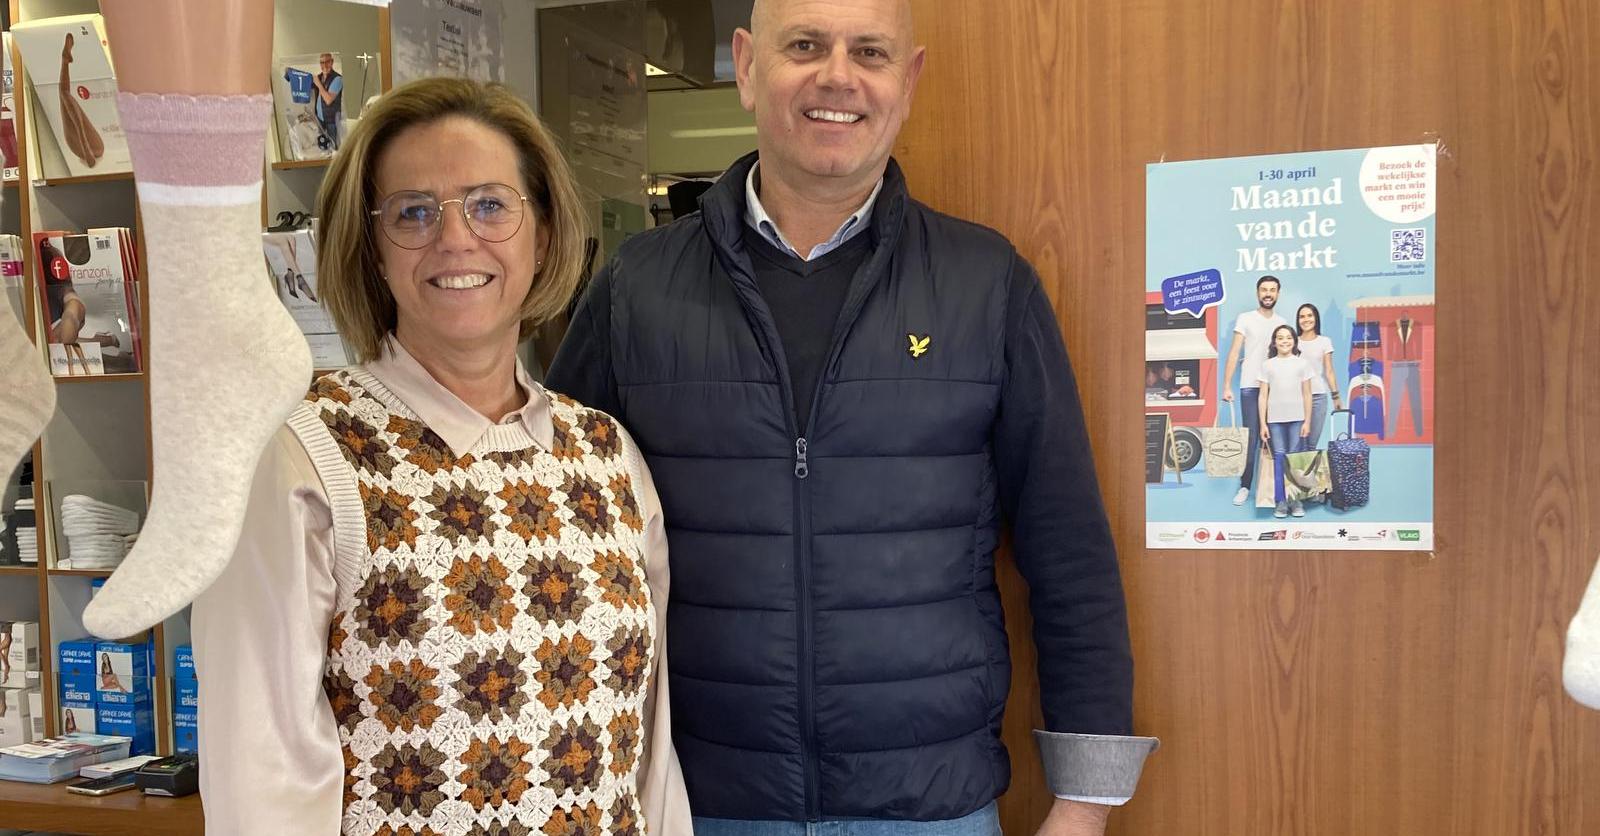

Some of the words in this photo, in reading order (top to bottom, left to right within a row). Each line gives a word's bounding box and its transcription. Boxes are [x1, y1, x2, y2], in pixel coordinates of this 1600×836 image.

[1379, 160, 1412, 170] Bezoek
[1414, 159, 1426, 168] de
[1259, 169, 1284, 181] 1-30
[1286, 166, 1316, 181] april
[1377, 171, 1425, 181] wekelijkse
[1364, 183, 1393, 192] markt
[1408, 180, 1425, 189] win
[1230, 177, 1344, 211] Maand
[1396, 191, 1425, 200] mooie
[1401, 201, 1425, 212] prijs!
[1235, 219, 1295, 241] van
[1297, 209, 1337, 239] de
[1235, 242, 1339, 273] Markt
[1173, 280, 1185, 289] De
[1185, 274, 1210, 285] markt,
[1168, 290, 1182, 298] een
[1183, 286, 1200, 296] feest
[1201, 282, 1218, 291] voor
[1173, 299, 1181, 308] je
[1181, 292, 1216, 304] zintuigen
